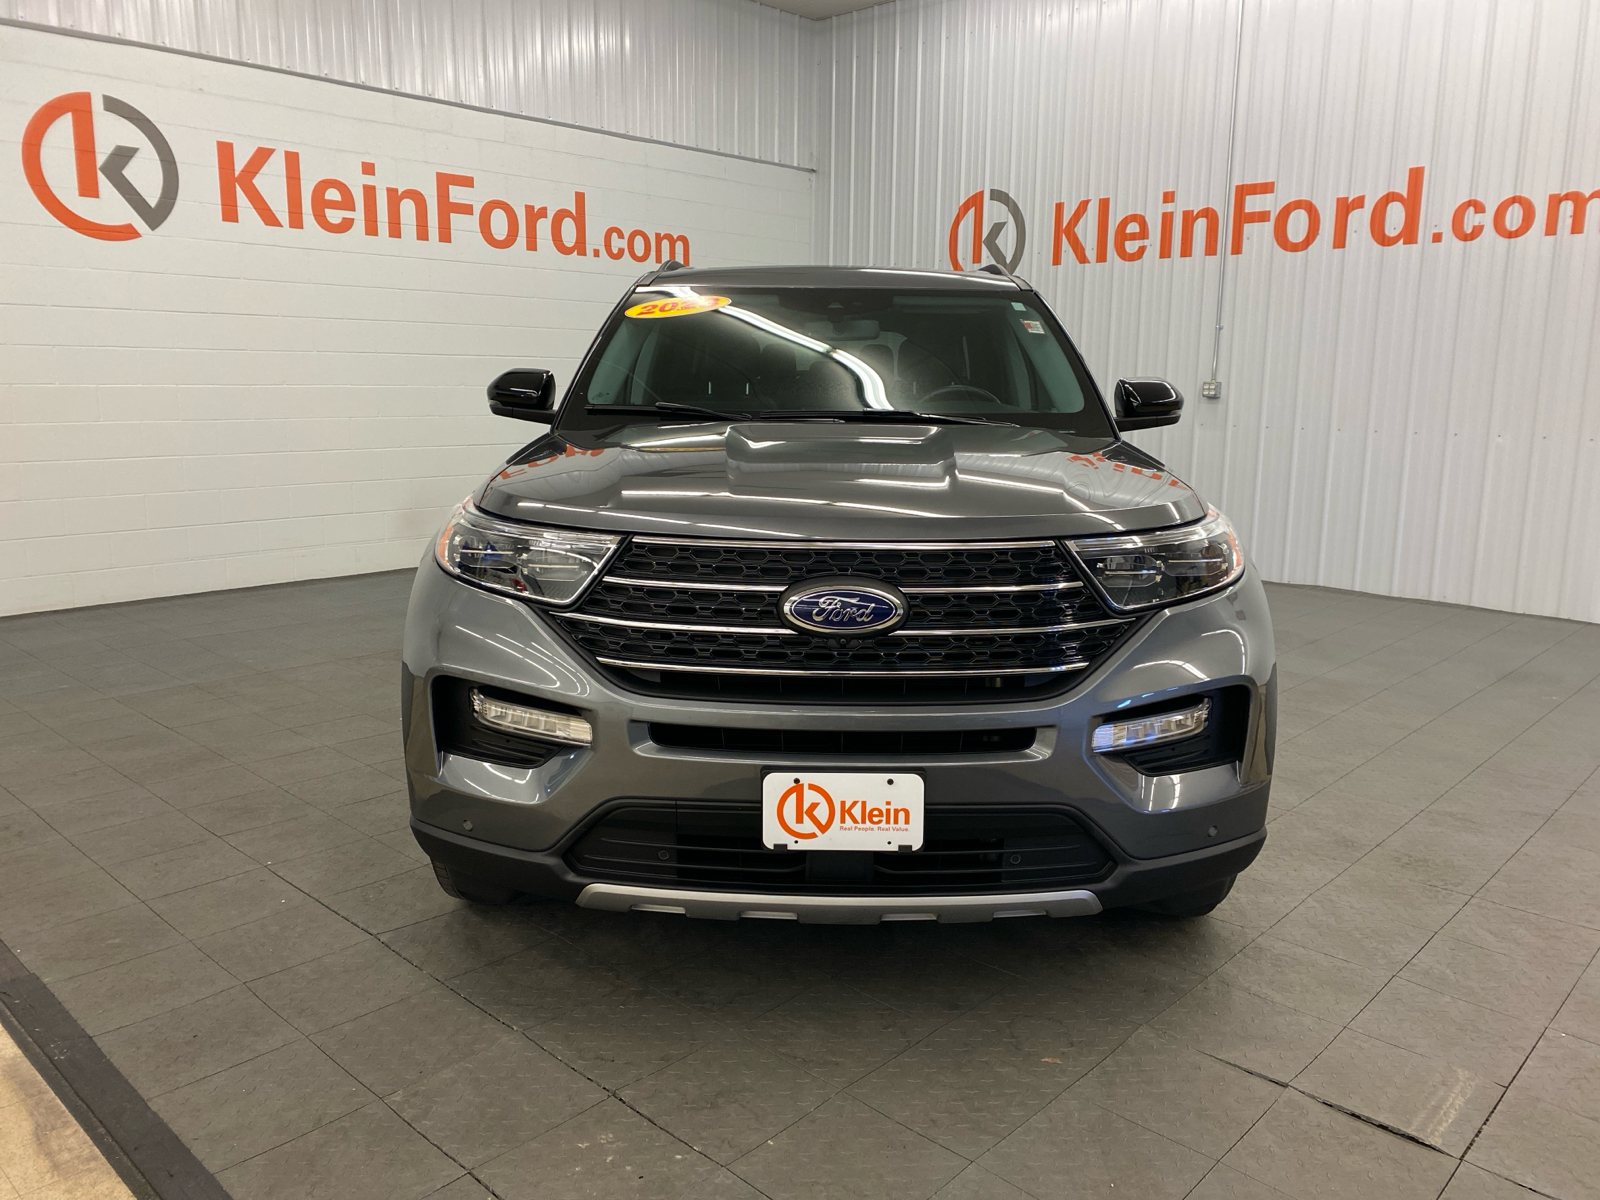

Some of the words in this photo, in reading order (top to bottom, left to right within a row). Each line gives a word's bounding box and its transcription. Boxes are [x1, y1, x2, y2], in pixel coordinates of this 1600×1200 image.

[215, 140, 690, 267] KleinFord.com
[1051, 165, 1600, 266] KleinFord.com
[811, 595, 876, 622] Ford
[839, 800, 910, 826] Klein
[854, 825, 875, 833] People.
